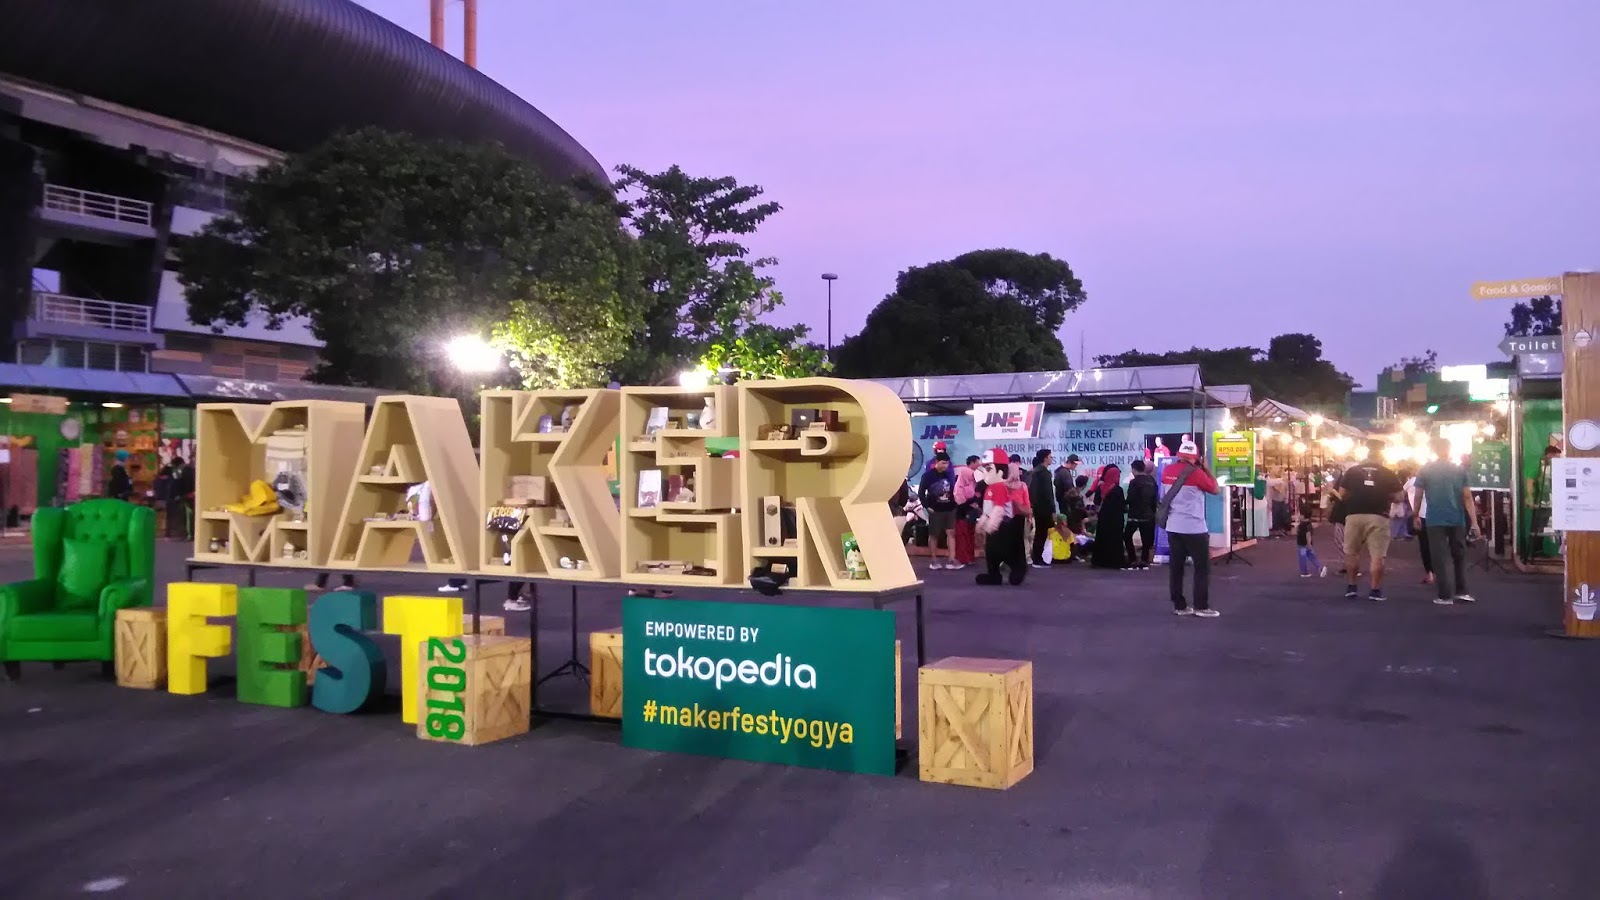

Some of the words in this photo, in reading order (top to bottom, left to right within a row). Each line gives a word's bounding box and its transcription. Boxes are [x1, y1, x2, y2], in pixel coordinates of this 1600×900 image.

[1479, 285, 1506, 295] Food
[1510, 284, 1518, 293] &
[1521, 283, 1557, 293] Goods
[1509, 341, 1556, 351] Toilet
[981, 411, 1023, 428] JNE
[920, 425, 960, 440] JNE
[1059, 429, 1082, 439] ULER
[1084, 428, 1113, 439] KEKET
[1071, 442, 1095, 452] NENG
[1098, 442, 1135, 452] CEDHAK
[1100, 455, 1125, 465] KIRIM
[195, 378, 916, 590] MAKER
[645, 621, 735, 641] EMPOWERED
[740, 626, 760, 643] BY
[167, 582, 464, 724] FEST
[644, 646, 817, 690] tokopedia
[426, 638, 467, 741] 2018
[643, 699, 855, 750] #makerfestyogya
